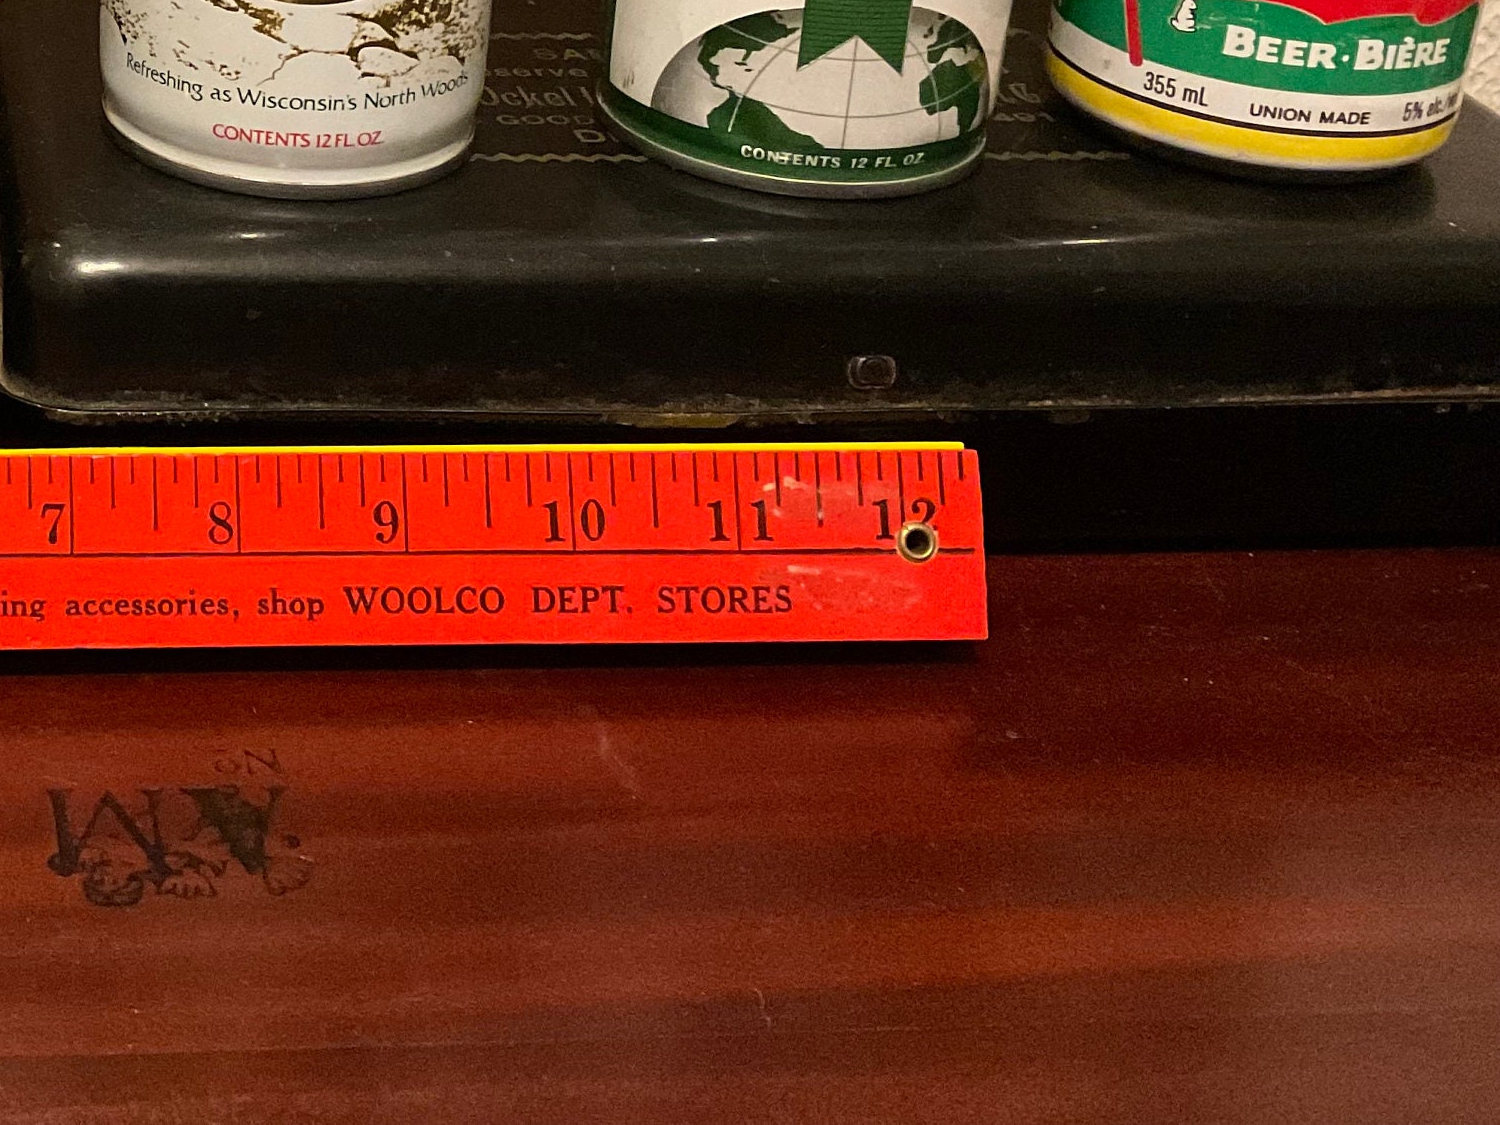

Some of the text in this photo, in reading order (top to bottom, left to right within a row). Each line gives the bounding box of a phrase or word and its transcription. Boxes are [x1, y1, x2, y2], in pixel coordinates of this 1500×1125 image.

[126, 51, 470, 112] Refreshing as Wisconsin's North Woods
[1143, 72, 1210, 107] 355 mL
[1249, 102, 1372, 125] UNION MADE
[1402, 101, 1424, 122] 5%
[211, 123, 310, 148] CONTENTS
[740, 144, 841, 168] CONTENTS
[851, 157, 868, 169] 12
[39, 502, 66, 546] 7
[207, 501, 234, 546] 8
[373, 500, 400, 544] 9
[544, 500, 606, 543] 10
[64, 592, 240, 621] accessories,
[256, 588, 325, 623] shop
[343, 586, 505, 615] WOOLCO
[531, 586, 634, 614] DEPT.
[657, 585, 794, 614] STORES
